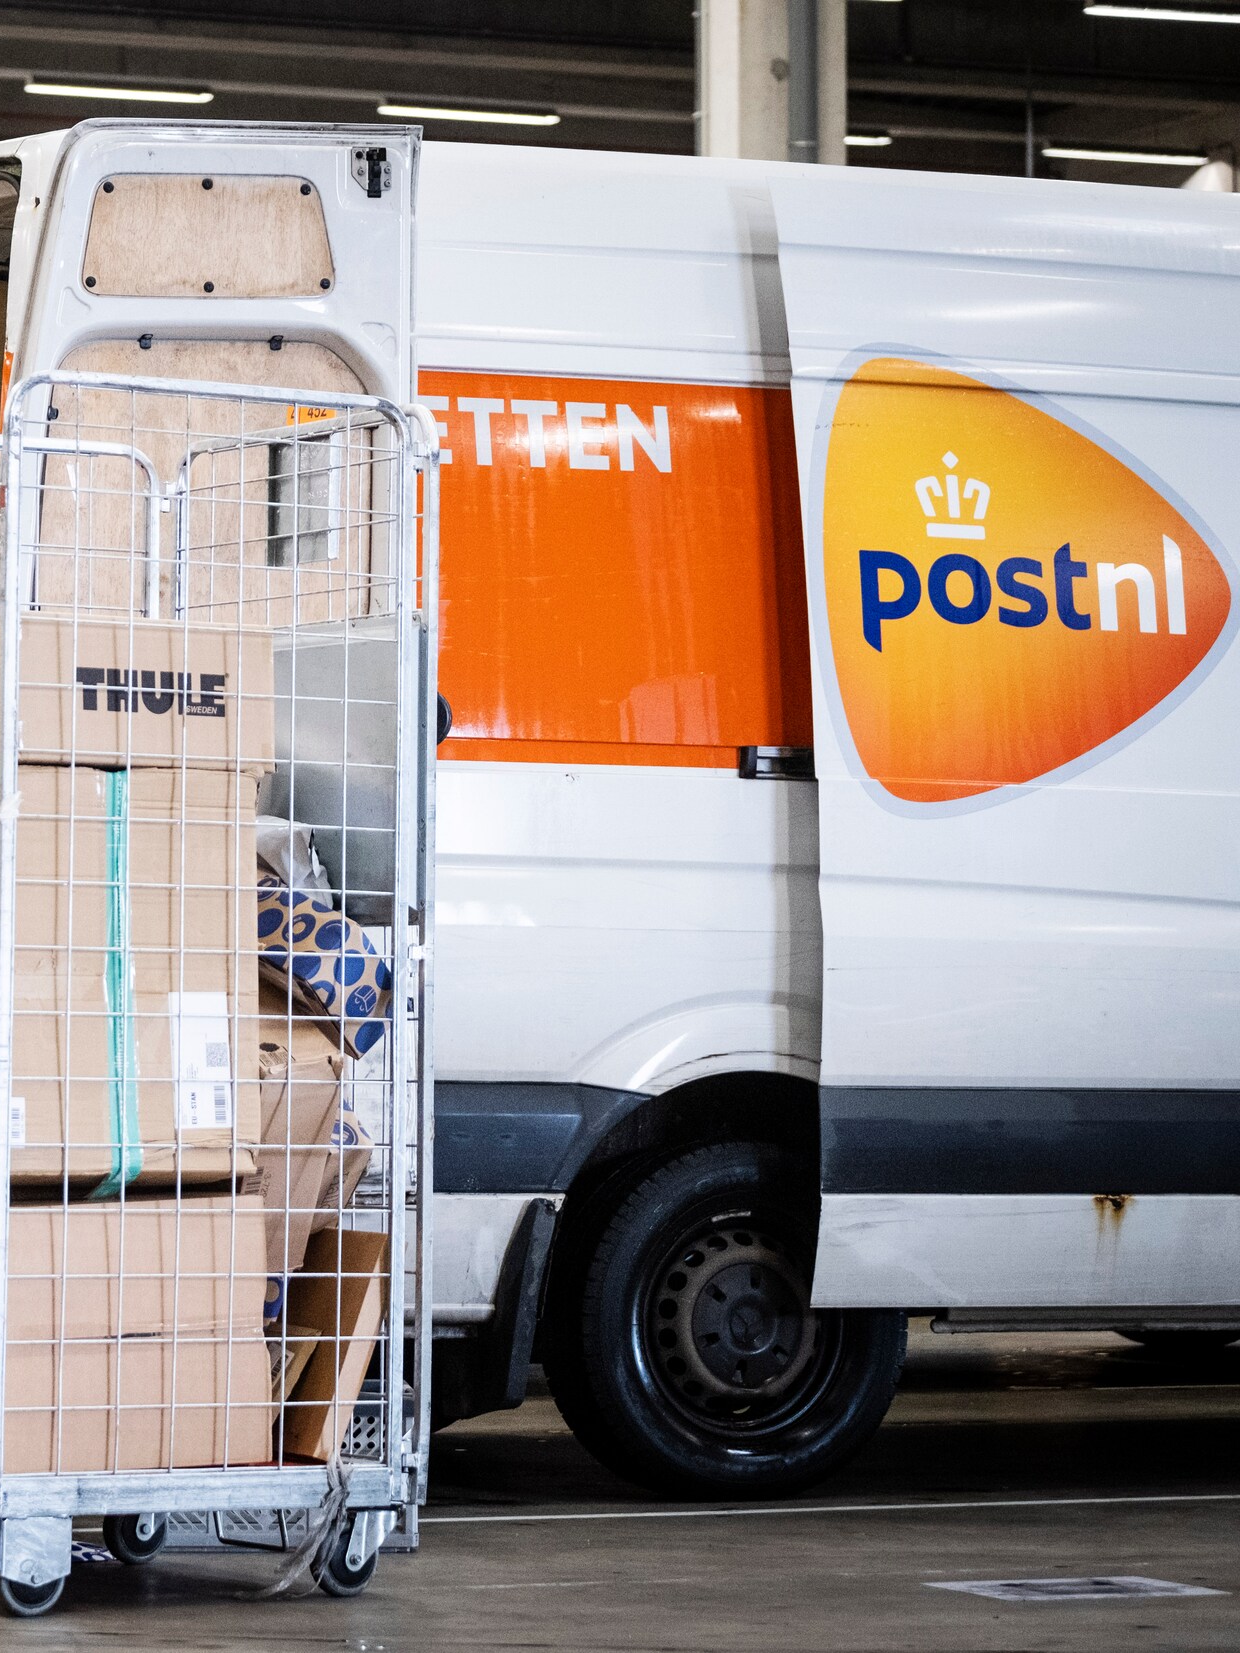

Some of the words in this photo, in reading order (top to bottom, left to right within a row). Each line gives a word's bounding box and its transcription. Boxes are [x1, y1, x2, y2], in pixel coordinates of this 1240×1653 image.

[859, 533, 1187, 653] postnl
[76, 667, 225, 718] THULE
[186, 705, 218, 714] SWEDEN
